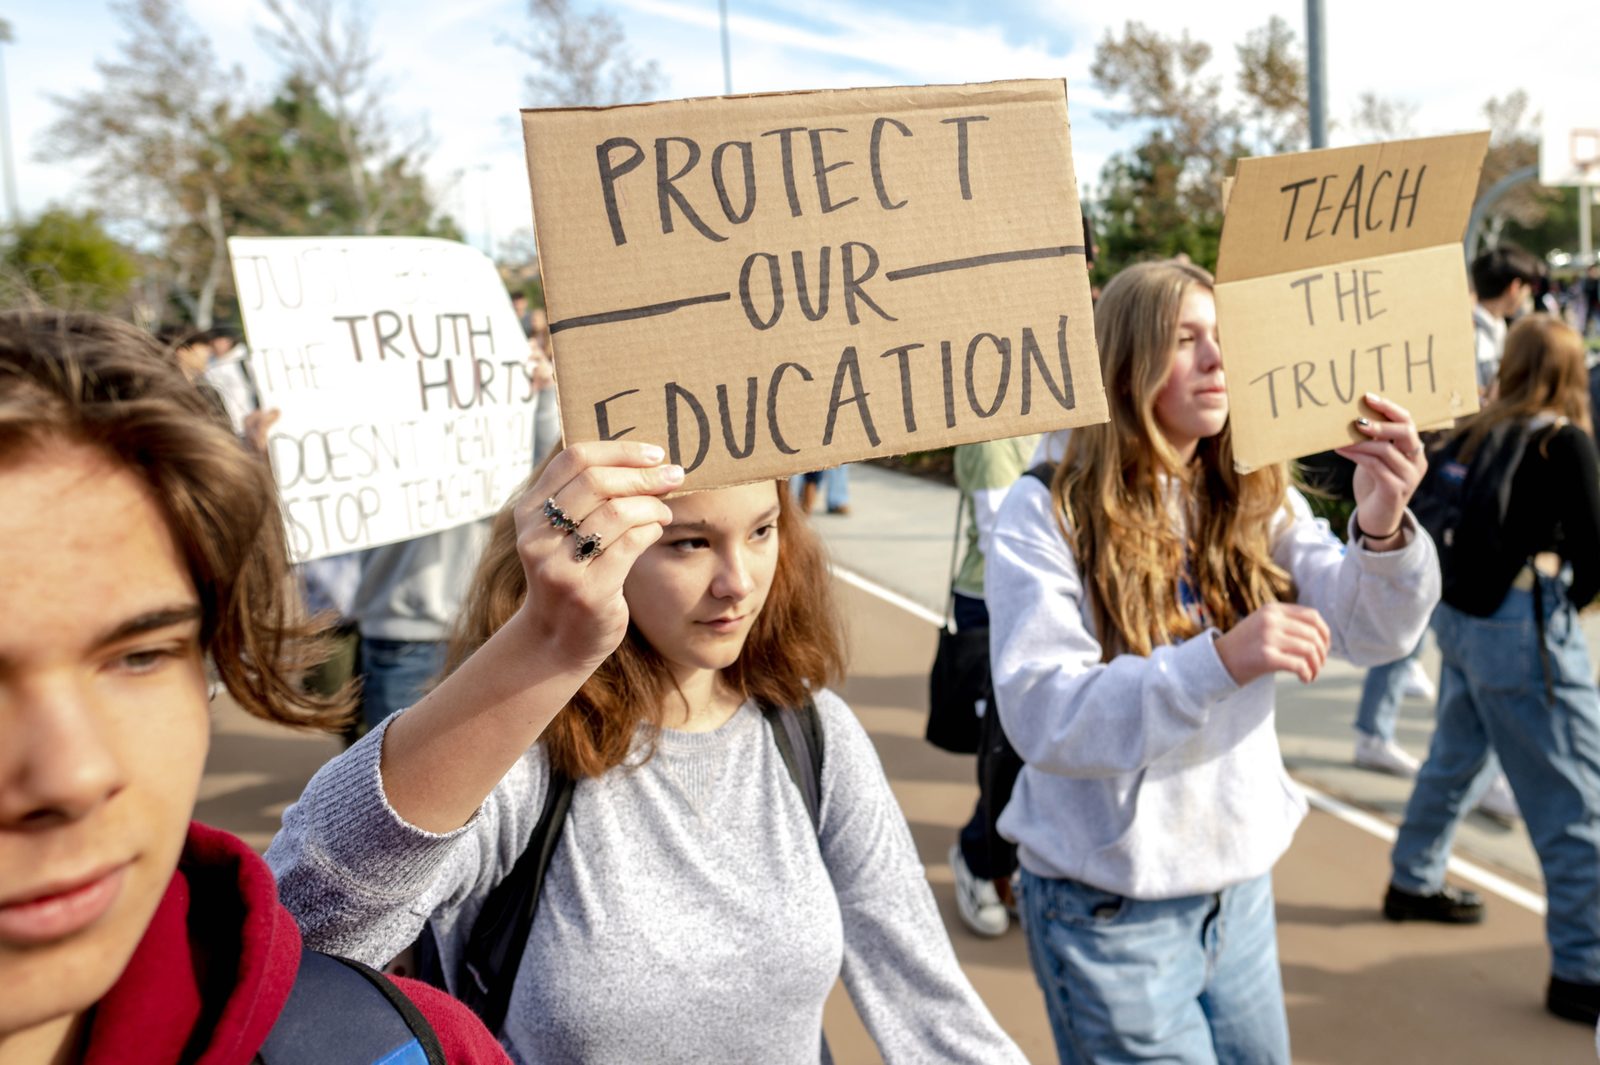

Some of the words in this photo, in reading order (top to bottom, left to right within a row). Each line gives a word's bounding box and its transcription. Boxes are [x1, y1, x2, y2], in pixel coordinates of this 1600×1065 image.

[596, 115, 990, 246] PROTECT
[1280, 164, 1427, 242] TEACH
[739, 242, 898, 330] OUR
[1290, 269, 1388, 326] THE
[332, 309, 495, 363] TRUTH
[417, 357, 535, 412] HURTS
[594, 315, 1077, 474] EDUCATION
[1249, 334, 1436, 419] TRUTH
[285, 486, 381, 560] STOP
